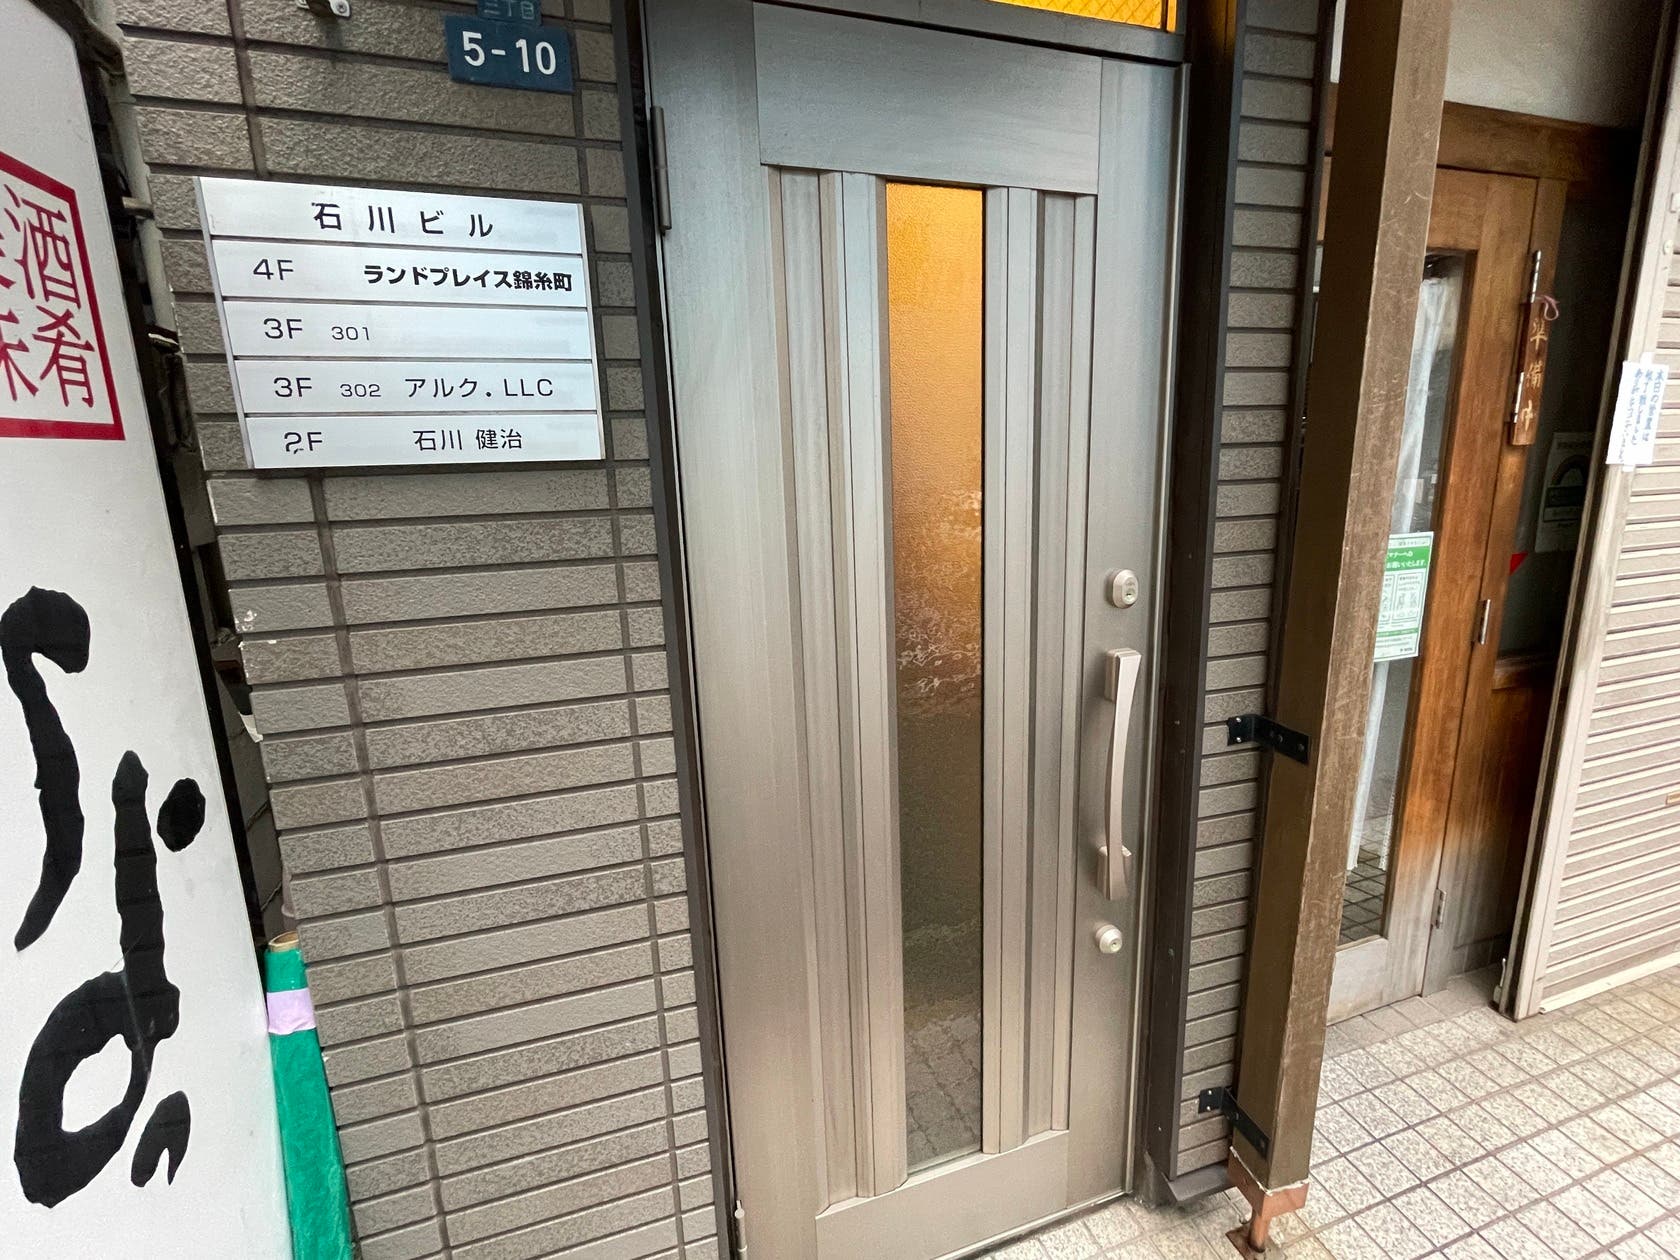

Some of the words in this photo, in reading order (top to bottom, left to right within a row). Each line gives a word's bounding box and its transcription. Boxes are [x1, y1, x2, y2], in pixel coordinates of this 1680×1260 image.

[462, 31, 556, 76] 5-10
[252, 258, 294, 281] 4F
[363, 265, 572, 292] ランドプレイス錦糸町
[4, 184, 95, 408] 酒肴
[263, 318, 303, 340] 3F
[331, 326, 370, 341] 301
[273, 377, 312, 398] 3F
[340, 383, 381, 398] 302
[284, 431, 323, 455] 2F
